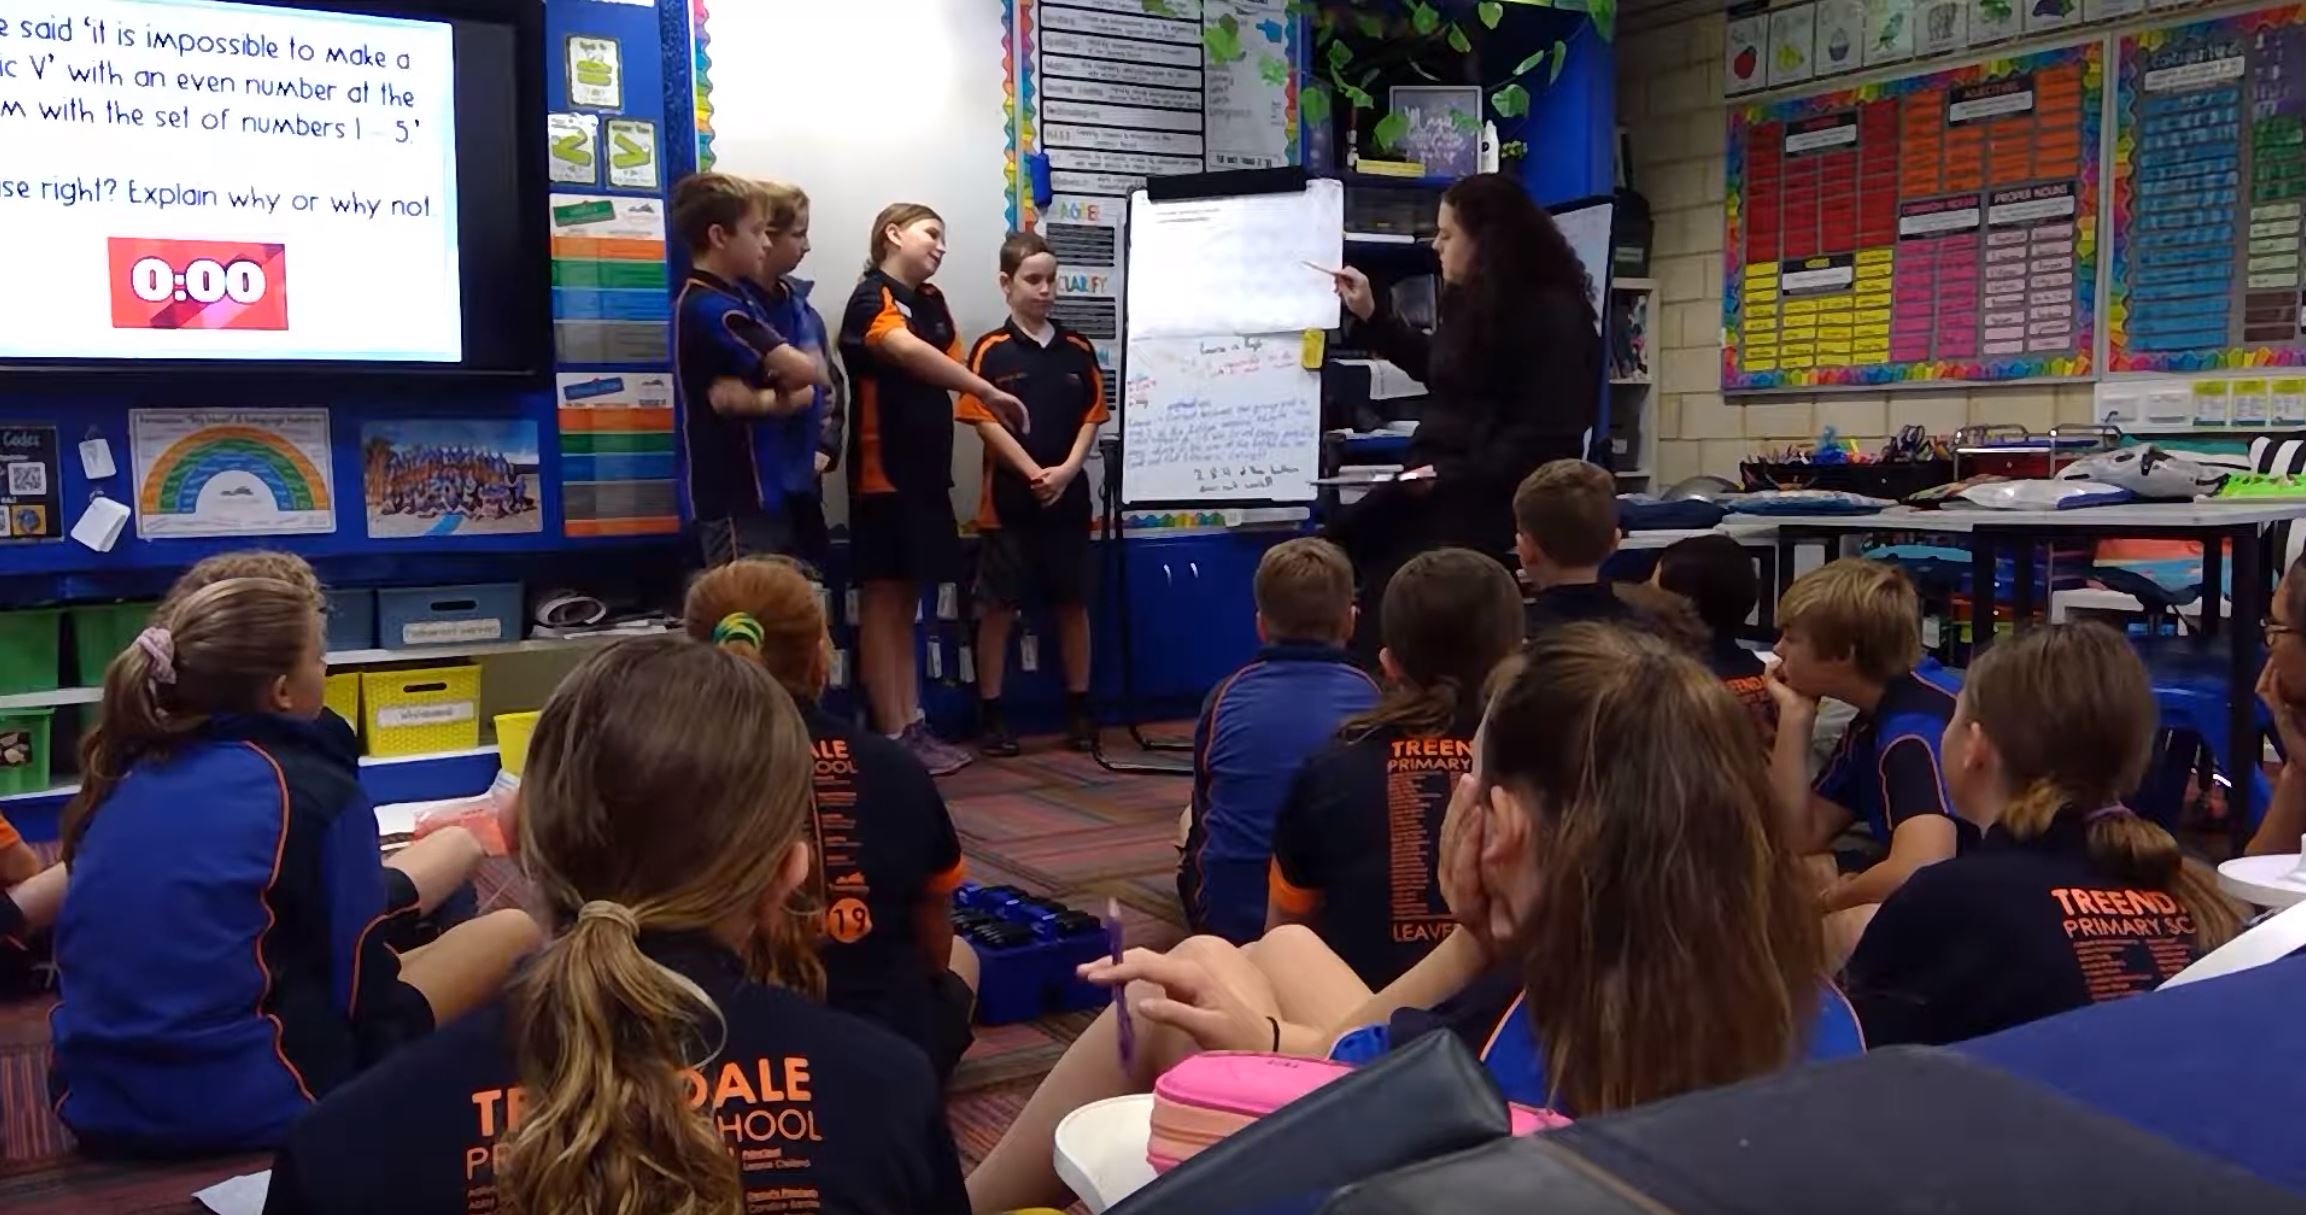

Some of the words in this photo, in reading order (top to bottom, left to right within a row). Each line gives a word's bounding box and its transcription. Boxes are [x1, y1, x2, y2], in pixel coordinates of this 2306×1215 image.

[20, 15, 72, 42] said
[118, 26, 135, 47] is
[146, 23, 278, 59] impossible
[290, 36, 314, 62] to
[325, 42, 386, 69] make
[397, 53, 410, 70] a
[68, 59, 123, 87] with
[134, 70, 165, 88] an
[177, 73, 235, 93] even
[245, 76, 337, 101] number
[347, 81, 368, 104] at
[381, 82, 414, 109] the
[39, 97, 94, 124] with
[107, 99, 144, 127] the
[156, 105, 188, 129] set
[201, 107, 229, 130] of
[242, 112, 345, 139] numbers
[41, 176, 116, 208] right?
[128, 179, 217, 209] Explain
[228, 185, 281, 215] why
[292, 194, 319, 212] or
[330, 191, 382, 220] why
[131, 256, 267, 304] 0:00
[1386, 757, 1472, 774] PRIMARY
[832, 906, 867, 935] 19
[2050, 888, 2187, 917] TREEND
[2062, 917, 2162, 939] PRIMARY
